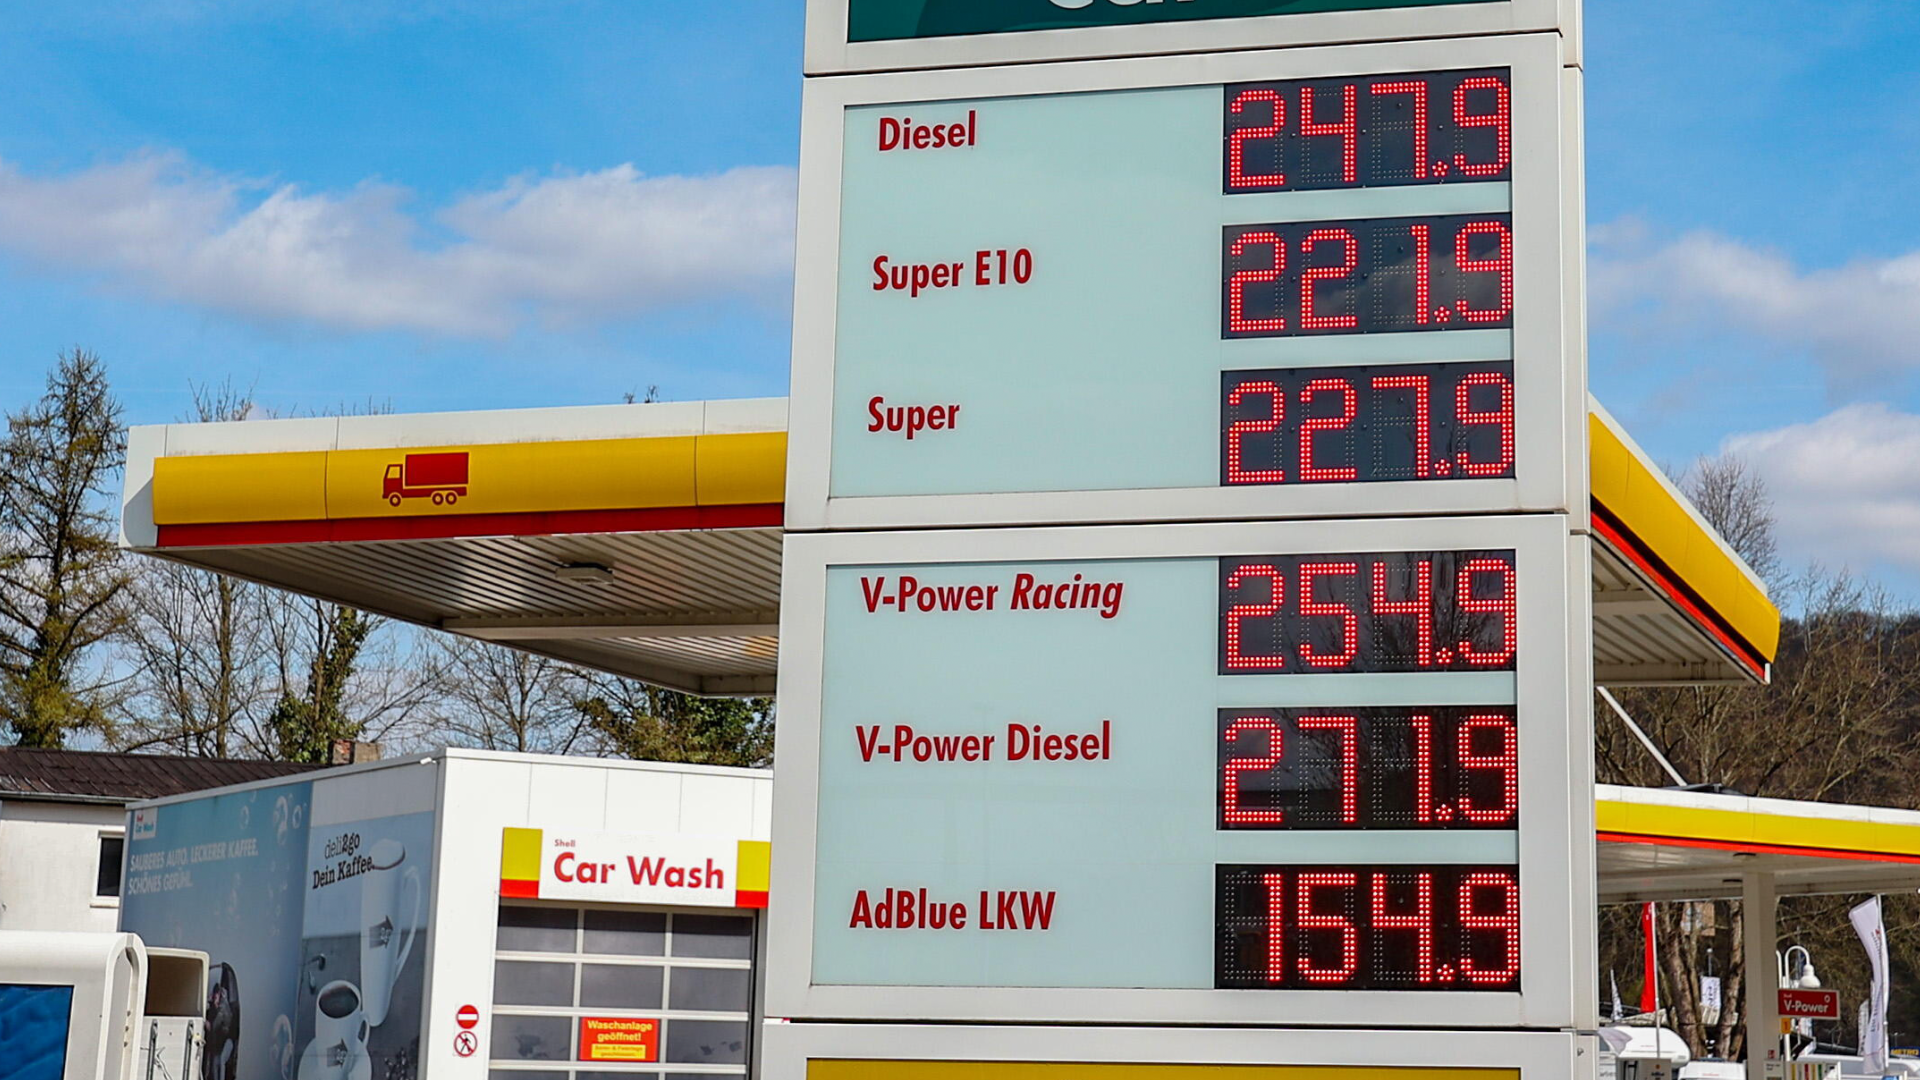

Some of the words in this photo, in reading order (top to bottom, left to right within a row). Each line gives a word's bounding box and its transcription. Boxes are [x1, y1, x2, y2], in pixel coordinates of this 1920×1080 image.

[879, 112, 976, 151] Diesel
[1228, 76, 1512, 189] 247.9
[874, 254, 962, 297] Super
[975, 248, 1032, 286] E10
[1227, 219, 1515, 334] 221.9
[869, 395, 961, 438] Super
[1226, 371, 1516, 485] 227.9
[861, 576, 998, 612] V-Power
[1011, 573, 1123, 619] Racing
[1224, 557, 1519, 671] 254.9
[856, 724, 995, 761] V-Power
[1007, 720, 1111, 761] Diesel
[1222, 713, 1520, 826] 271.9
[130, 851, 165, 872] SAUBERES
[324, 832, 361, 859] deli2go
[554, 839, 576, 847] Shell
[312, 865, 335, 890] Dein
[554, 852, 616, 884] Car
[626, 855, 724, 890] Wash
[851, 887, 967, 930] AdBlue
[981, 891, 1057, 930] LKW
[1261, 871, 1522, 985] 154.9
[587, 1020, 653, 1032] Waschanlage
[1783, 999, 1829, 1013] V-Power
[597, 1032, 642, 1042] geöffnet!
